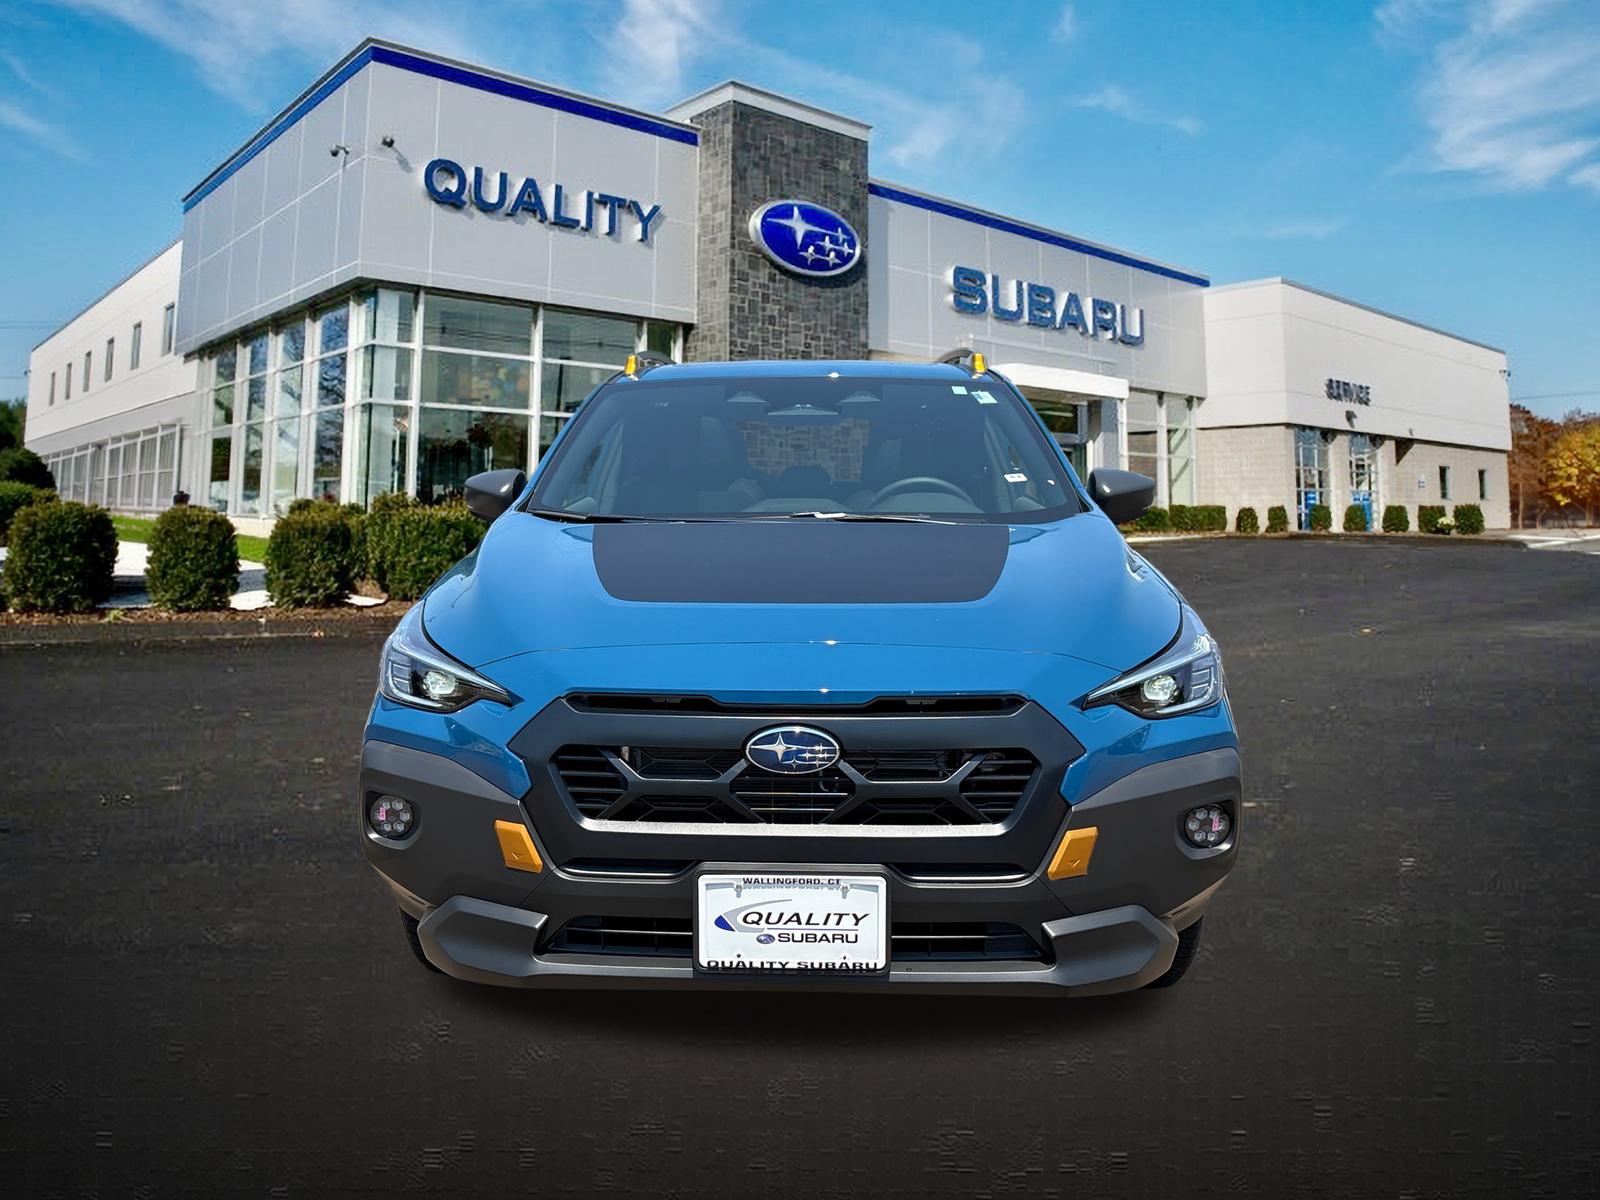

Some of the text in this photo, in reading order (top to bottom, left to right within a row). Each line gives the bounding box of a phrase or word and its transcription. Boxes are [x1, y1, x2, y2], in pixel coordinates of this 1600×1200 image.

[424, 158, 661, 242] QUALITY
[951, 265, 1145, 347] SUBARU
[742, 911, 870, 926] QUALITY
[777, 932, 859, 944] SUBARU
[707, 960, 878, 970] QUALITY SUBARU
